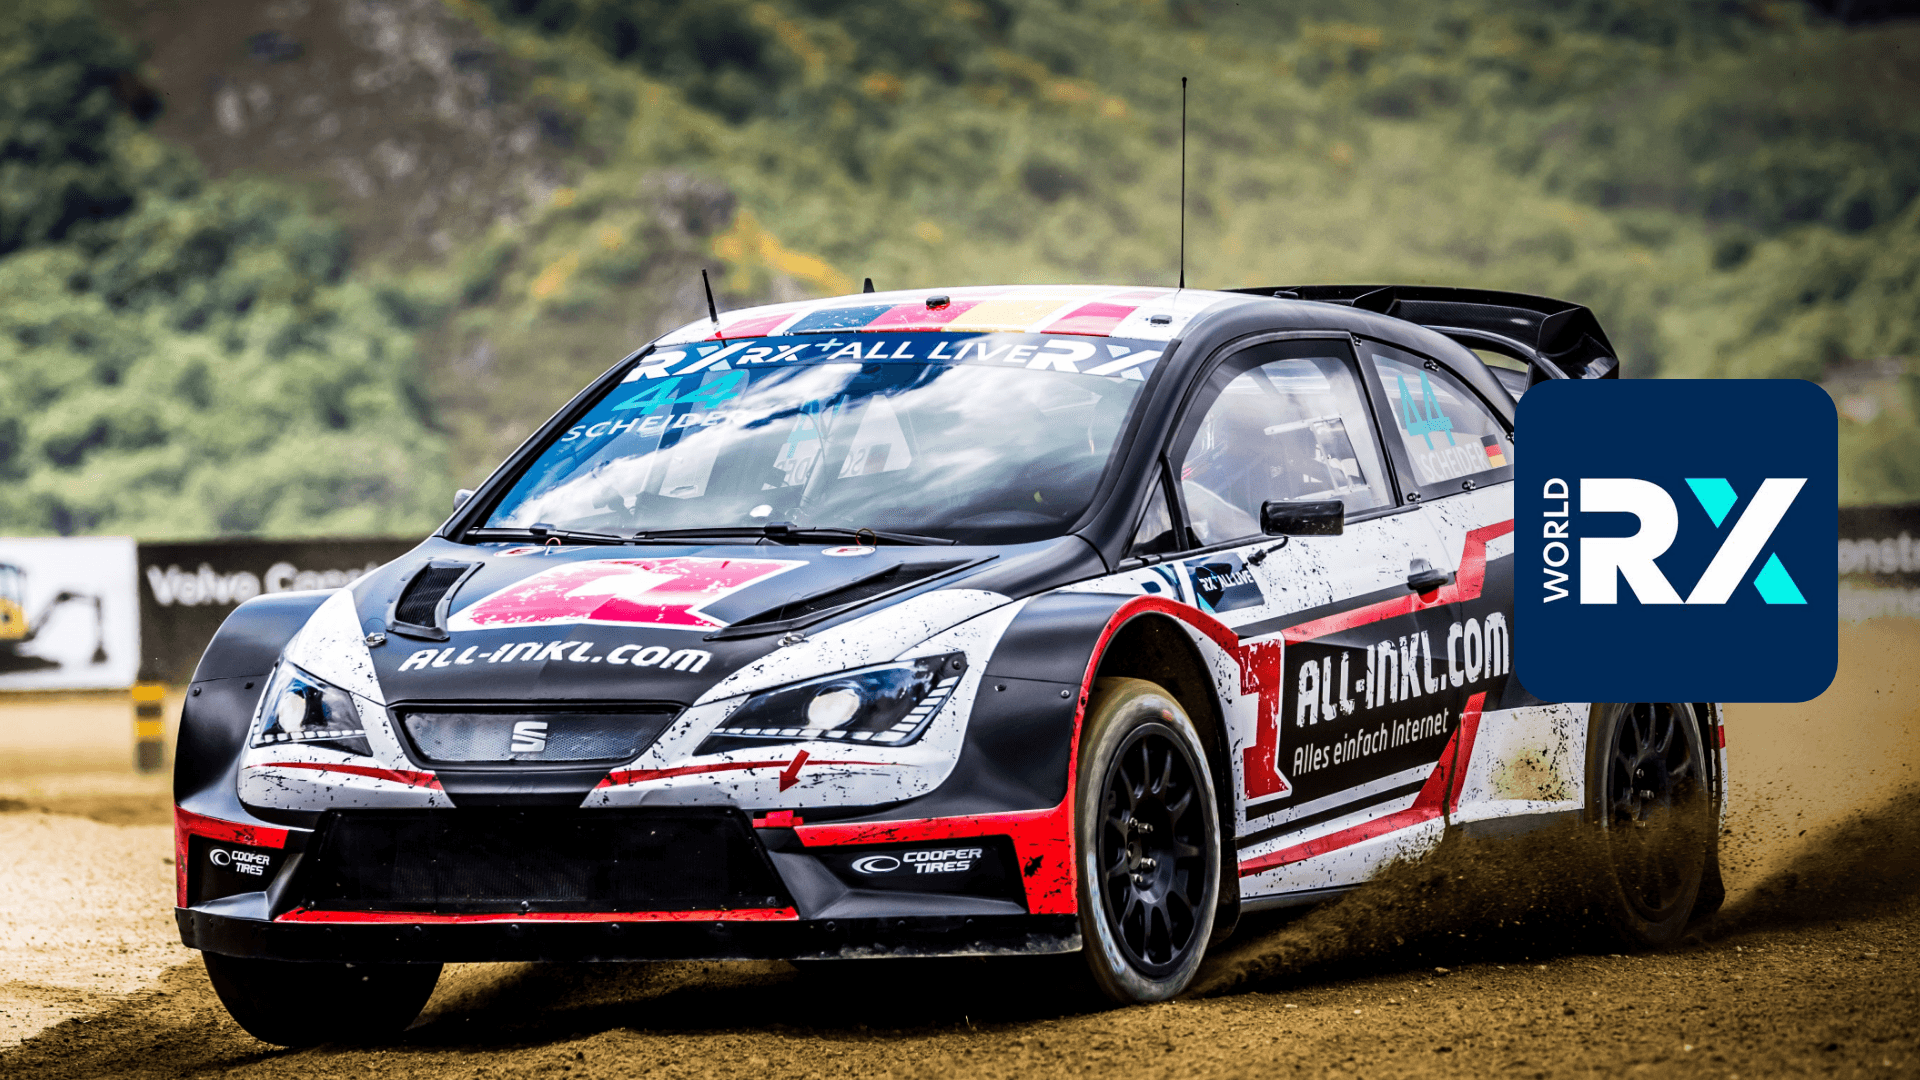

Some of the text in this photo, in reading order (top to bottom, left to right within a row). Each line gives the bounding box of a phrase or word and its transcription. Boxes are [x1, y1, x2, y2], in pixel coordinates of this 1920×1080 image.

[621, 341, 756, 384] RX
[927, 341, 1033, 363] LIVE
[1025, 339, 1164, 381] RX
[611, 370, 746, 415] 44
[1397, 370, 1456, 450] 44
[561, 410, 750, 442] SCHEIDER
[1420, 441, 1488, 482] SCHEIDER
[147, 561, 380, 606] Volvo Con
[1233, 569, 1255, 586] LIVE
[398, 641, 711, 674] ALL-INKL.COM
[1296, 611, 1510, 728] ALL-INKL.COM
[1292, 707, 1449, 777] Alles einfach Internet
[231, 850, 271, 866] COOPER
[235, 862, 264, 876] TIRES
[903, 848, 983, 863] COOPER
[914, 860, 970, 874] TIRES
